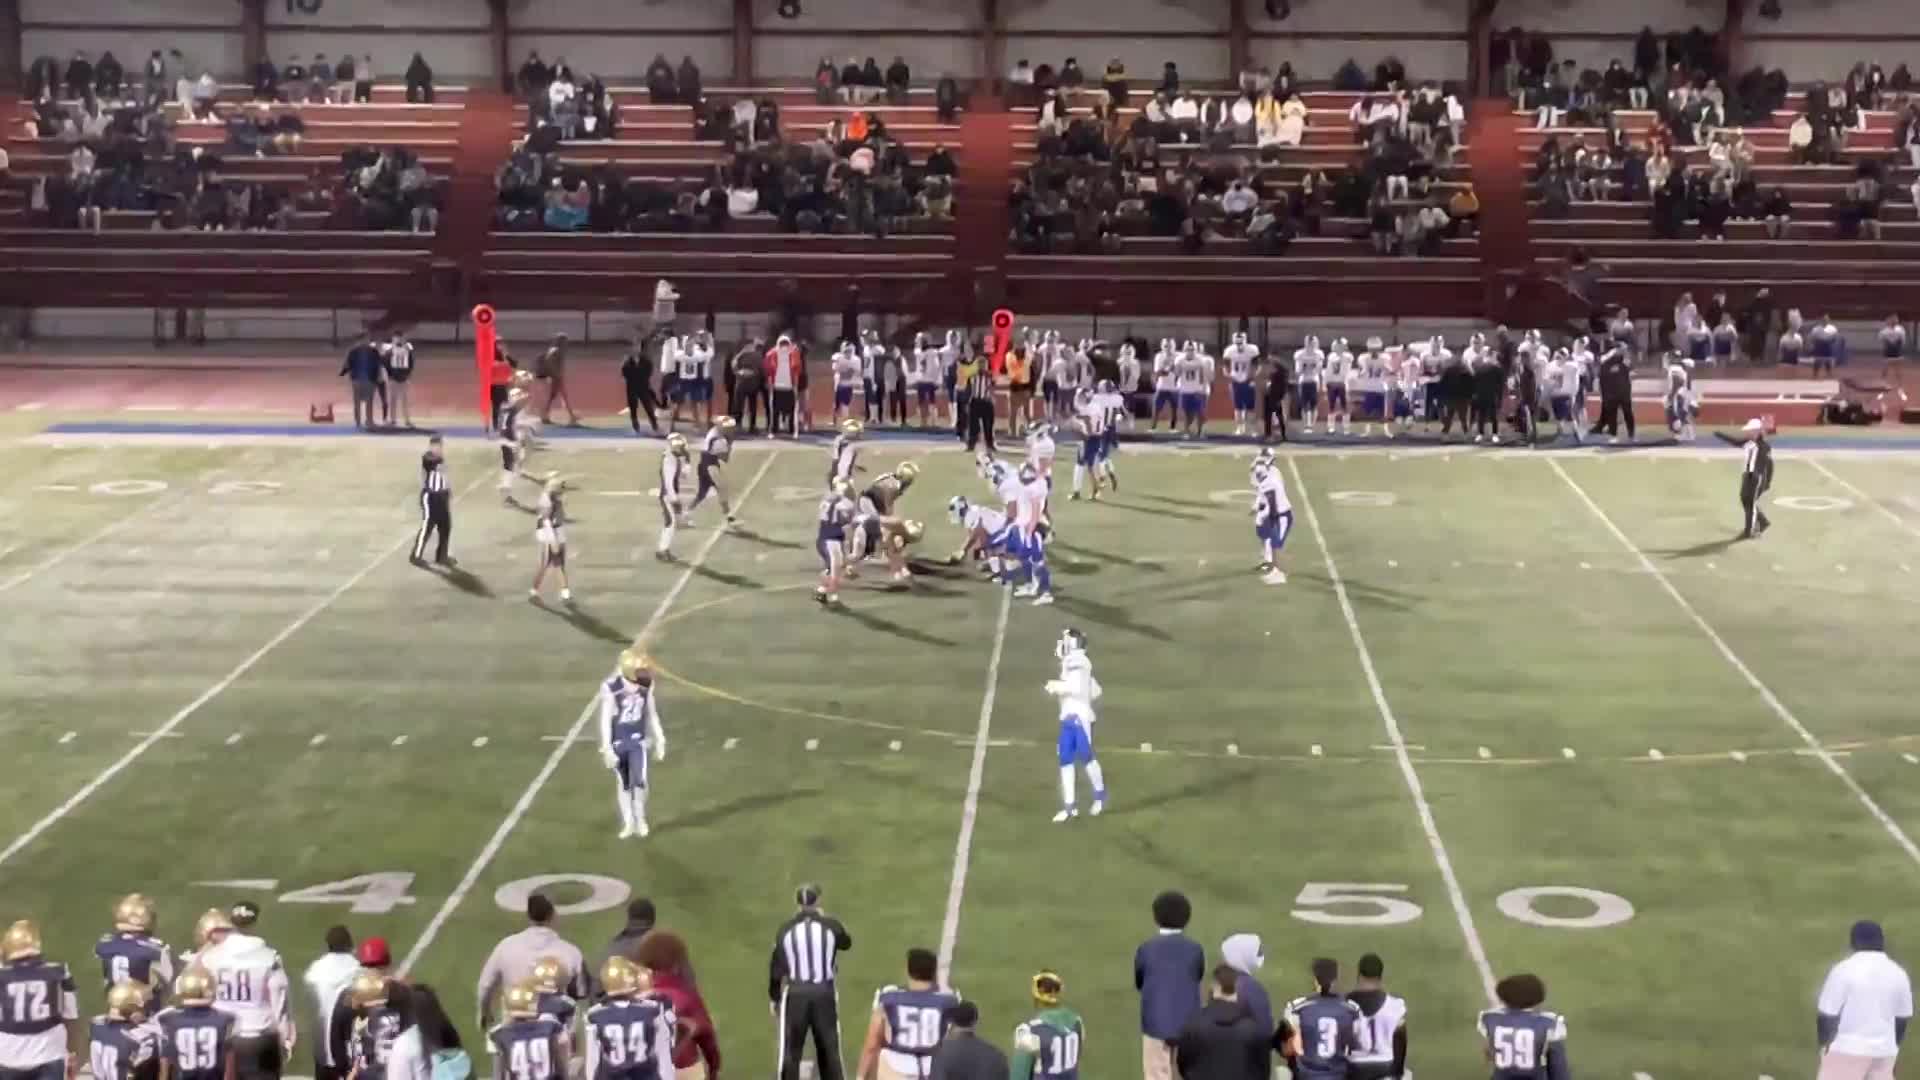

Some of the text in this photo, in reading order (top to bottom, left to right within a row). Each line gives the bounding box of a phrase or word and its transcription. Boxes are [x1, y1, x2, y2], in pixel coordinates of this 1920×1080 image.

[7, 980, 50, 1022] 72
[217, 970, 251, 1001] 58
[175, 1026, 218, 1070] 93
[604, 1021, 648, 1065] 34
[1048, 1031, 1079, 1075] 10
[1317, 1016, 1338, 1058] 3
[1494, 1026, 1535, 1069] 59
